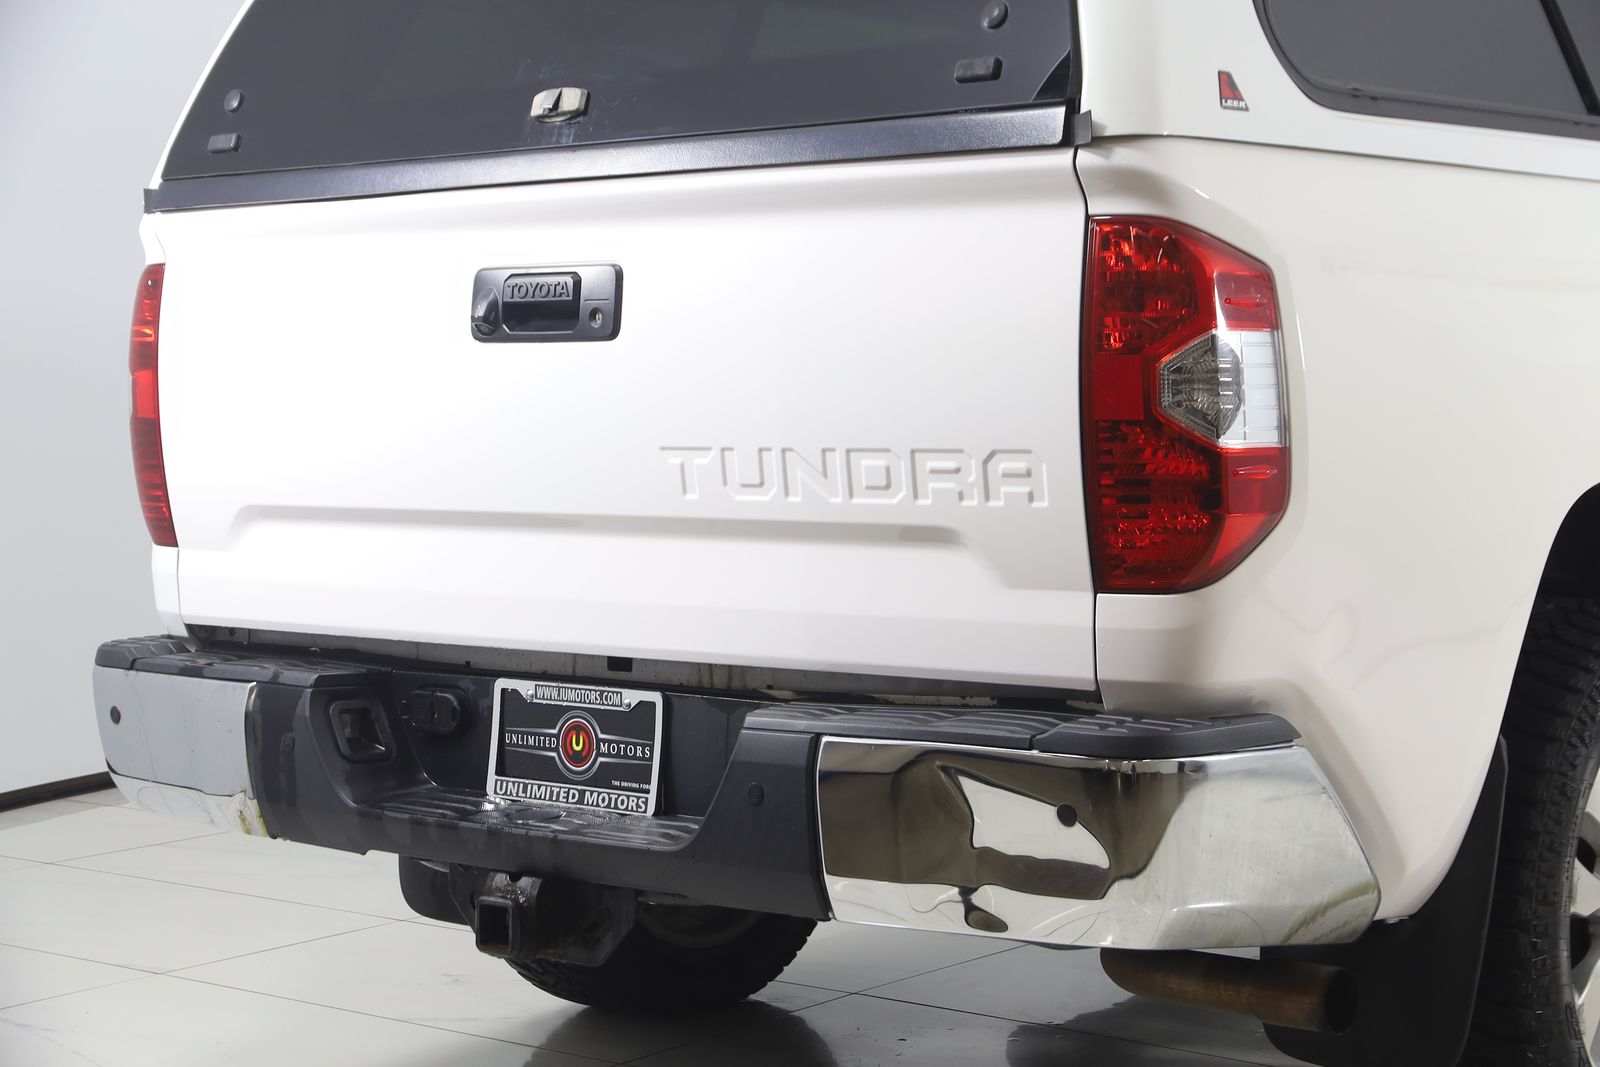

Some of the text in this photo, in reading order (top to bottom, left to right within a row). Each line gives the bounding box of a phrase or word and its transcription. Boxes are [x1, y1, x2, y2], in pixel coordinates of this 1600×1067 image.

[507, 281, 570, 299] TOYOTA
[659, 446, 1048, 507] TUNDRA
[536, 686, 621, 706] WWW.IUMOTORS.COM
[505, 733, 557, 748] UNLIMITED
[599, 742, 650, 757] MOTORS
[496, 780, 646, 811] UNLIMITED MOTORS
